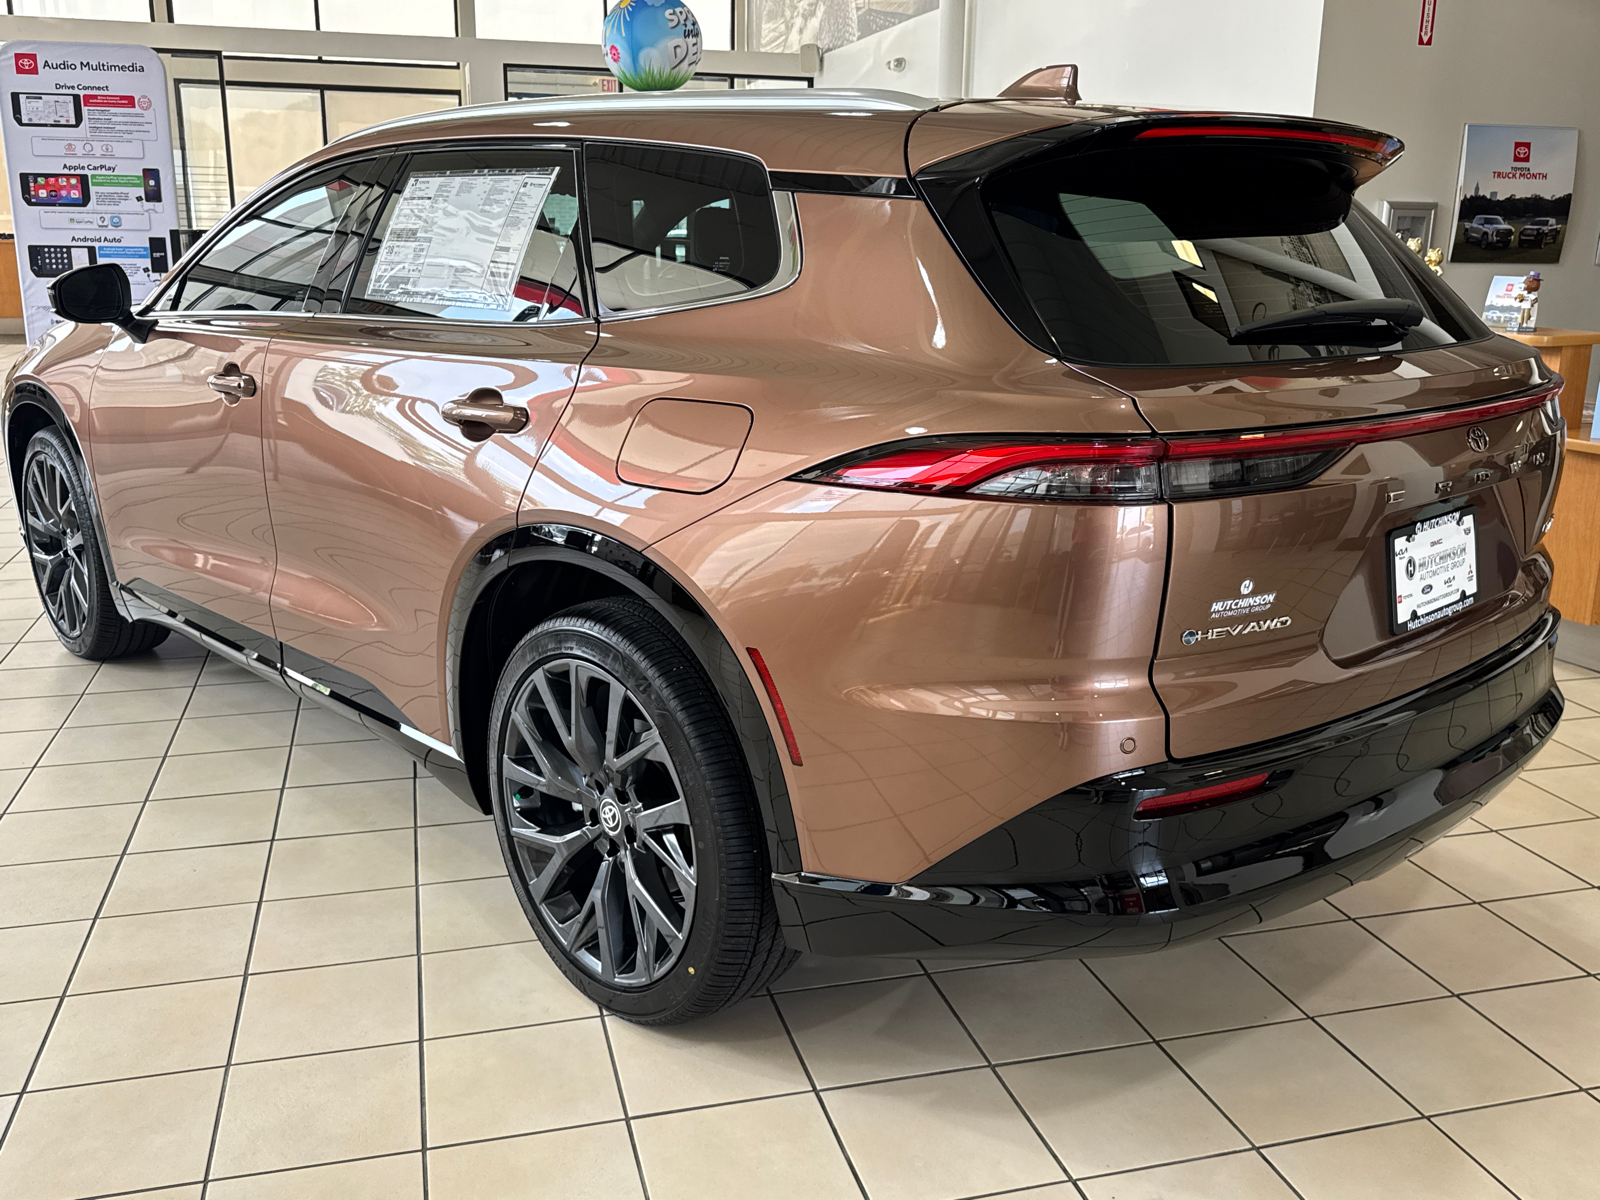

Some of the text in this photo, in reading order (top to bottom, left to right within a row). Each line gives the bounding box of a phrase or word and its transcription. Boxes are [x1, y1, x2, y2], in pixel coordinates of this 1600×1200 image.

[42, 60, 145, 73] Audio Multimedia
[55, 83, 109, 92] Drive Connect
[601, 79, 617, 93] EXIT
[62, 163, 86, 172] Apple
[1492, 171, 1548, 181] TRUCK MONTH
[1423, 511, 1461, 531] HUTCHINSON
[1430, 538, 1443, 547] GMC
[1418, 542, 1467, 573] HUTCHINSON
[1419, 557, 1466, 582] AUTOMOTIVE GROUP
[1211, 593, 1275, 612] HUTCHINSON
[1211, 604, 1271, 619] AUTOMOTIVE GROUP
[1407, 597, 1474, 632] Hutchinsonautogroup.com
